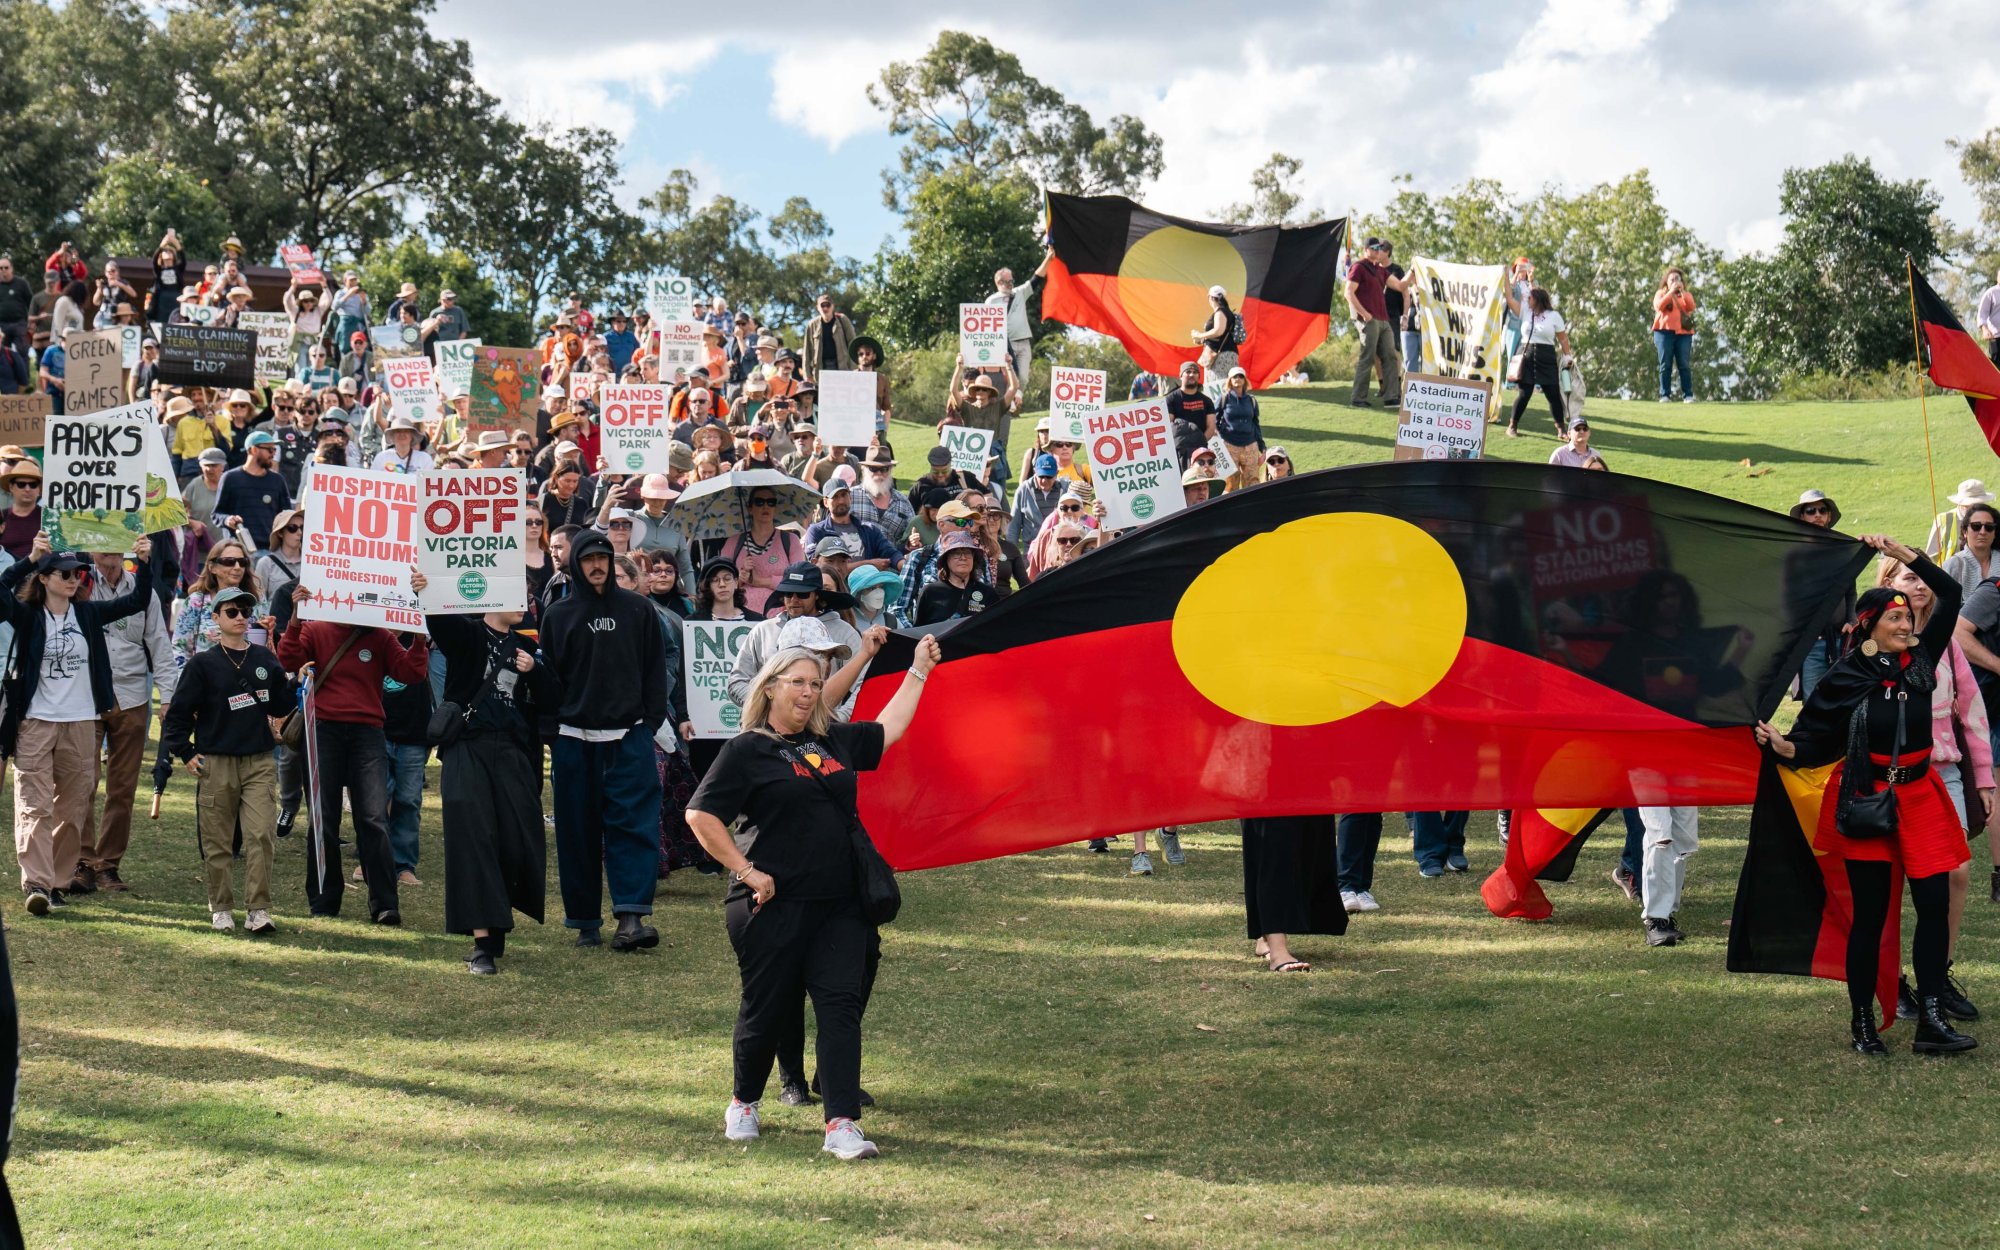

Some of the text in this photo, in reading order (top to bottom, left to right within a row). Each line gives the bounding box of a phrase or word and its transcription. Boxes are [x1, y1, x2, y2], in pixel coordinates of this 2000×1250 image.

[655, 281, 686, 294] NO
[1431, 277, 1488, 309] ALWAYS
[186, 306, 211, 321] NO
[241, 314, 270, 324] KEEP
[1447, 308, 1473, 335] WAS
[675, 325, 690, 333] NO
[964, 317, 1004, 332] OFF
[165, 327, 248, 342] STILL CLAIMING
[70, 339, 115, 360] GREEN
[166, 337, 247, 351] TERRA NULLIUS
[441, 343, 475, 362] NO
[89, 363, 101, 384] ?
[193, 360, 226, 373] END?
[387, 361, 428, 371] HANDS
[390, 372, 430, 388] OFF
[1056, 371, 1102, 384] HANDS
[67, 386, 118, 411] GAMES
[605, 389, 663, 401] HANDS
[1055, 383, 1102, 403] OFF
[1409, 383, 1484, 402] A stadium at
[1, 399, 44, 413] SPECT
[1055, 401, 1100, 411] VICTORIA
[1405, 398, 1483, 418] Victoria Park
[605, 404, 664, 426] OFF
[1088, 406, 1163, 434] HANDS
[1413, 413, 1472, 430] is a LOSS
[52, 422, 142, 458] PARKS
[606, 429, 663, 438] VICTORIA
[946, 431, 985, 453] NO
[1399, 426, 1482, 450] (not a legacy)
[619, 440, 650, 448] PARK
[1093, 426, 1166, 465] OFF
[1212, 441, 1230, 470] PARKS
[68, 460, 117, 477] OVER
[1098, 458, 1173, 481] VICTORIA
[425, 476, 518, 497] HANDS
[1118, 475, 1159, 493] PARK
[48, 480, 142, 512] PROFITS
[324, 495, 417, 542] NOT
[424, 498, 518, 535] OFF
[1553, 506, 1621, 547] NO
[425, 536, 518, 552] VICTORIA
[305, 554, 350, 569] TRAFFIC
[446, 553, 497, 569] PARK
[1535, 539, 1649, 572] STADIUMS
[326, 569, 397, 586] CONGESTION
[1535, 559, 1650, 586] VICTORIA PARK
[385, 610, 422, 626] KILLS
[694, 626, 751, 659] NO
[693, 662, 733, 673] STAD
[693, 676, 728, 687] VICT
[230, 694, 251, 704] HANDS
[710, 690, 730, 700] PA
